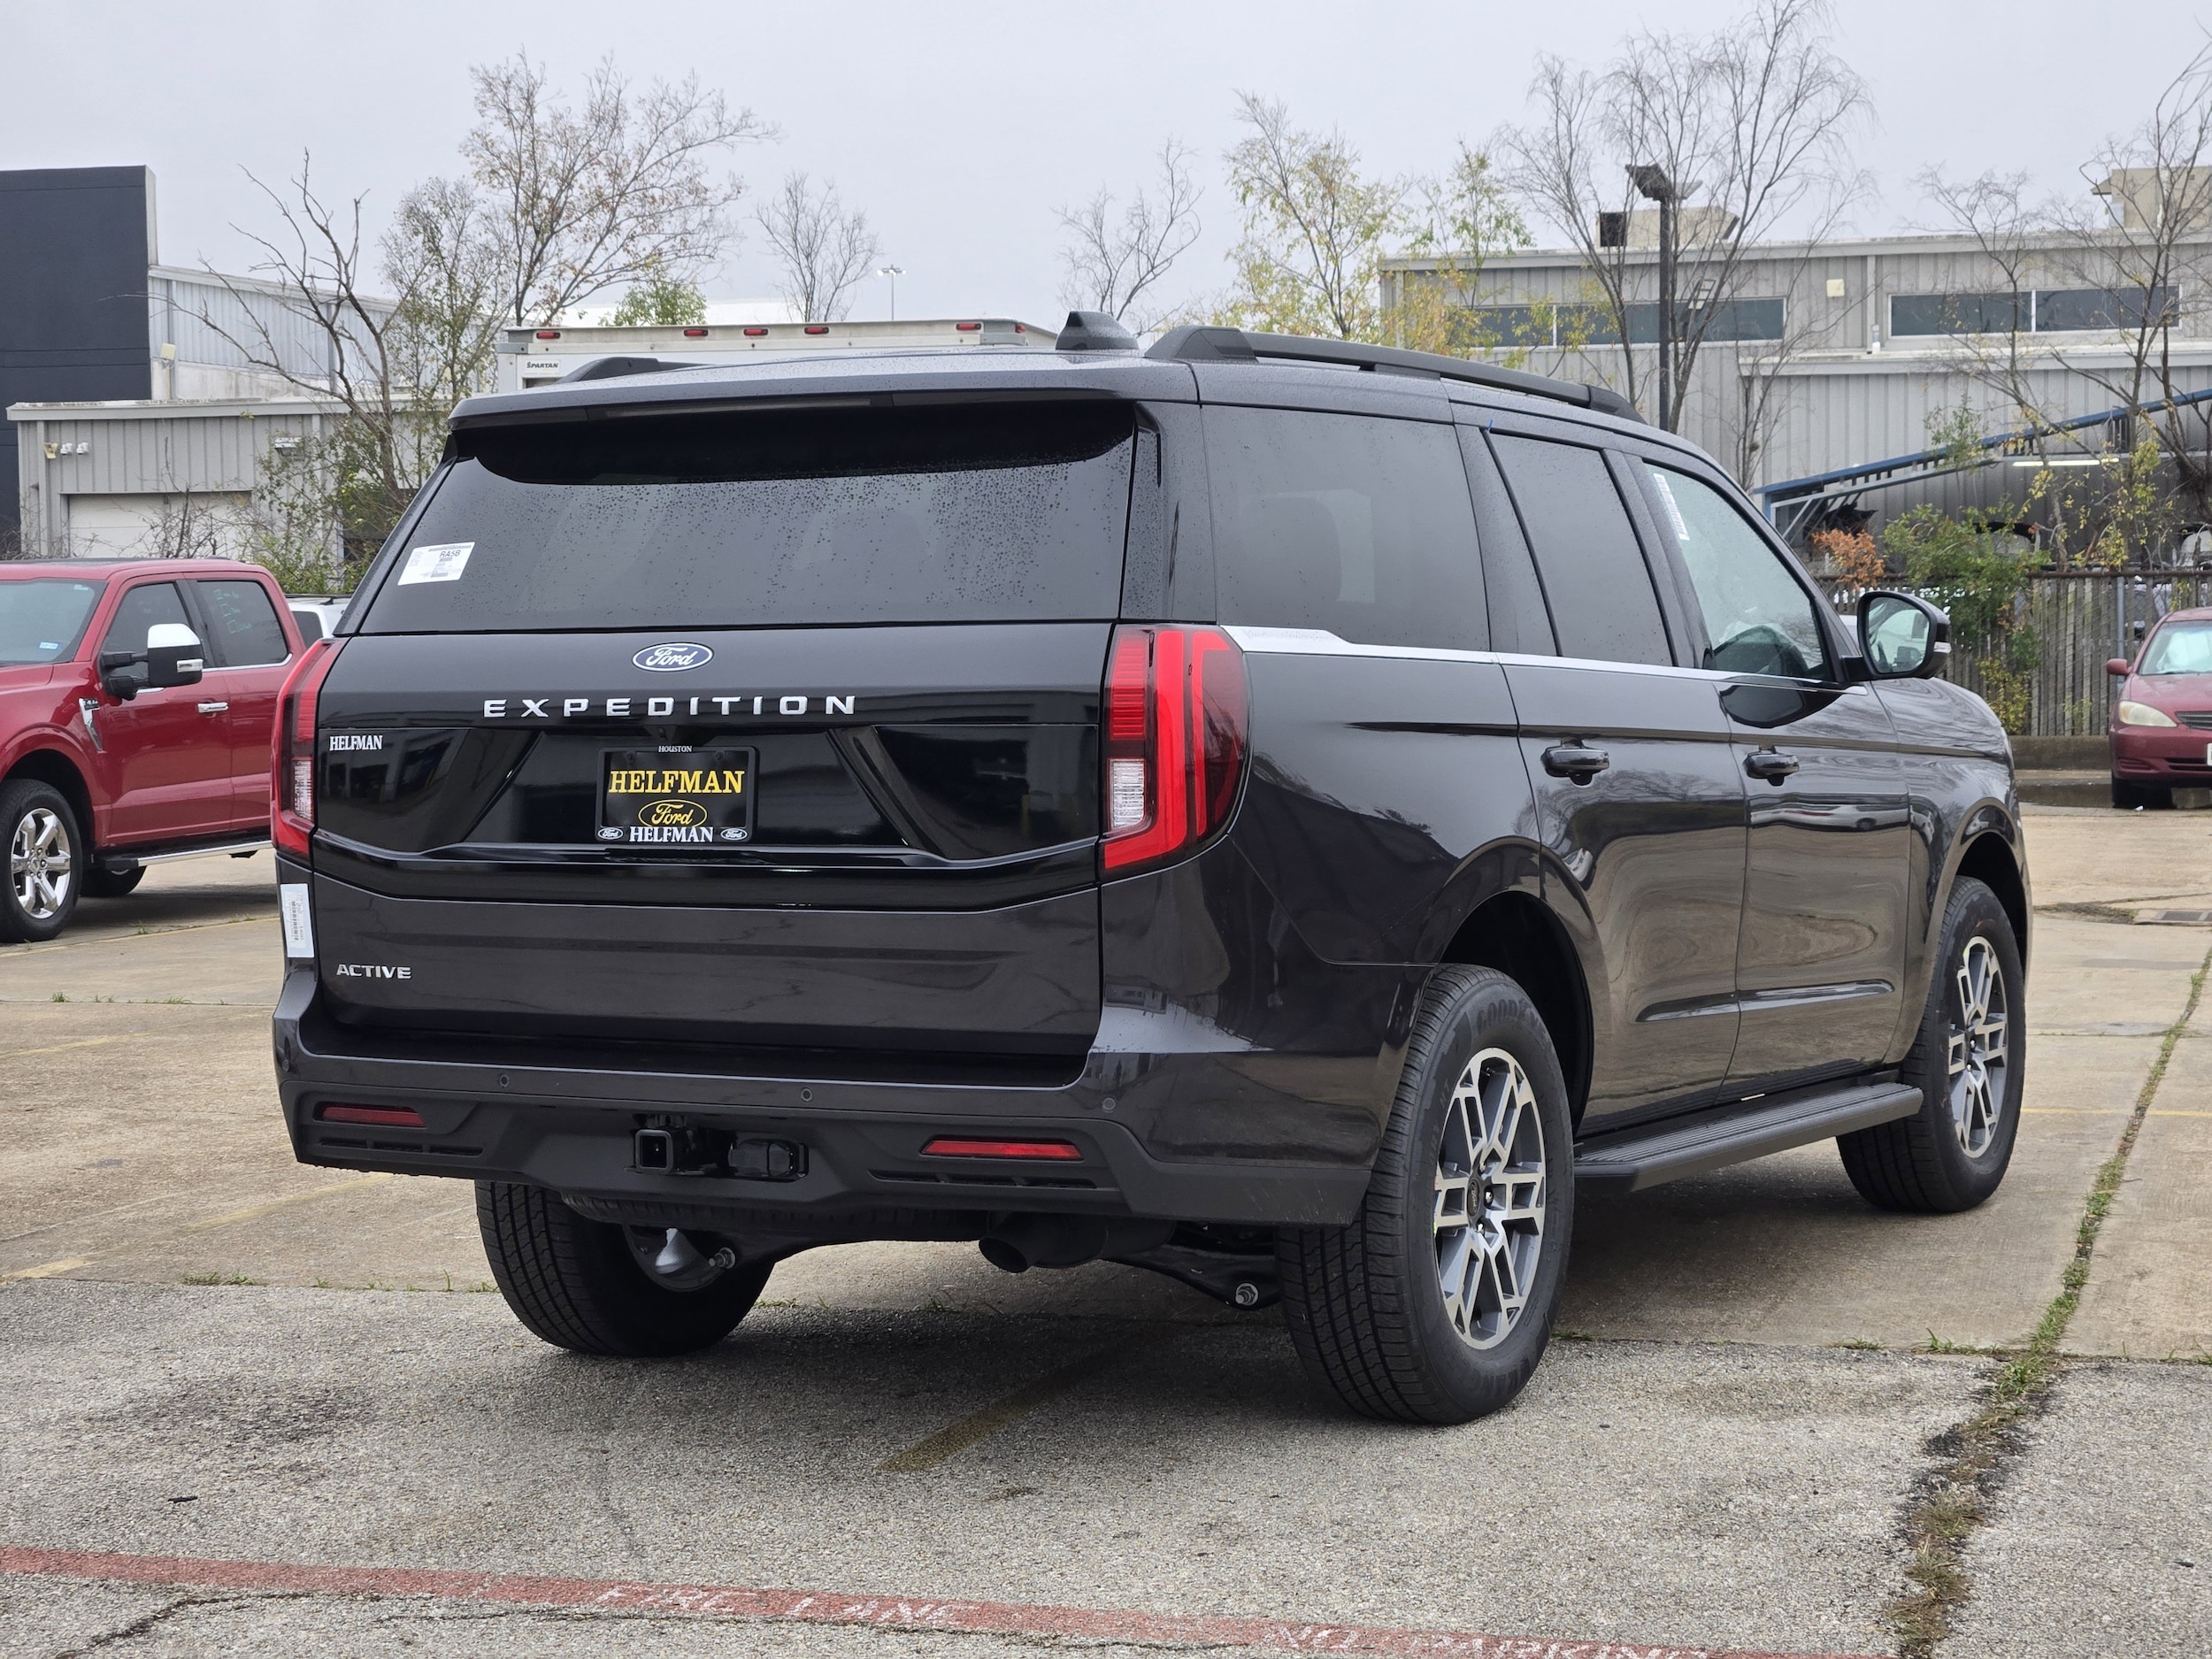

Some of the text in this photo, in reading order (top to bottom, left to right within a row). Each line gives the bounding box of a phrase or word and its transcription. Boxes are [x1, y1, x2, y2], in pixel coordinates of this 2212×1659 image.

[645, 646, 698, 666] Ford
[483, 695, 856, 718] EXPEDITION
[329, 734, 383, 751] HELFMAN
[608, 770, 745, 794] HELFMAN
[650, 803, 695, 825] Ford
[629, 826, 714, 842] HELFMAN
[336, 964, 411, 979] ACTIVE
